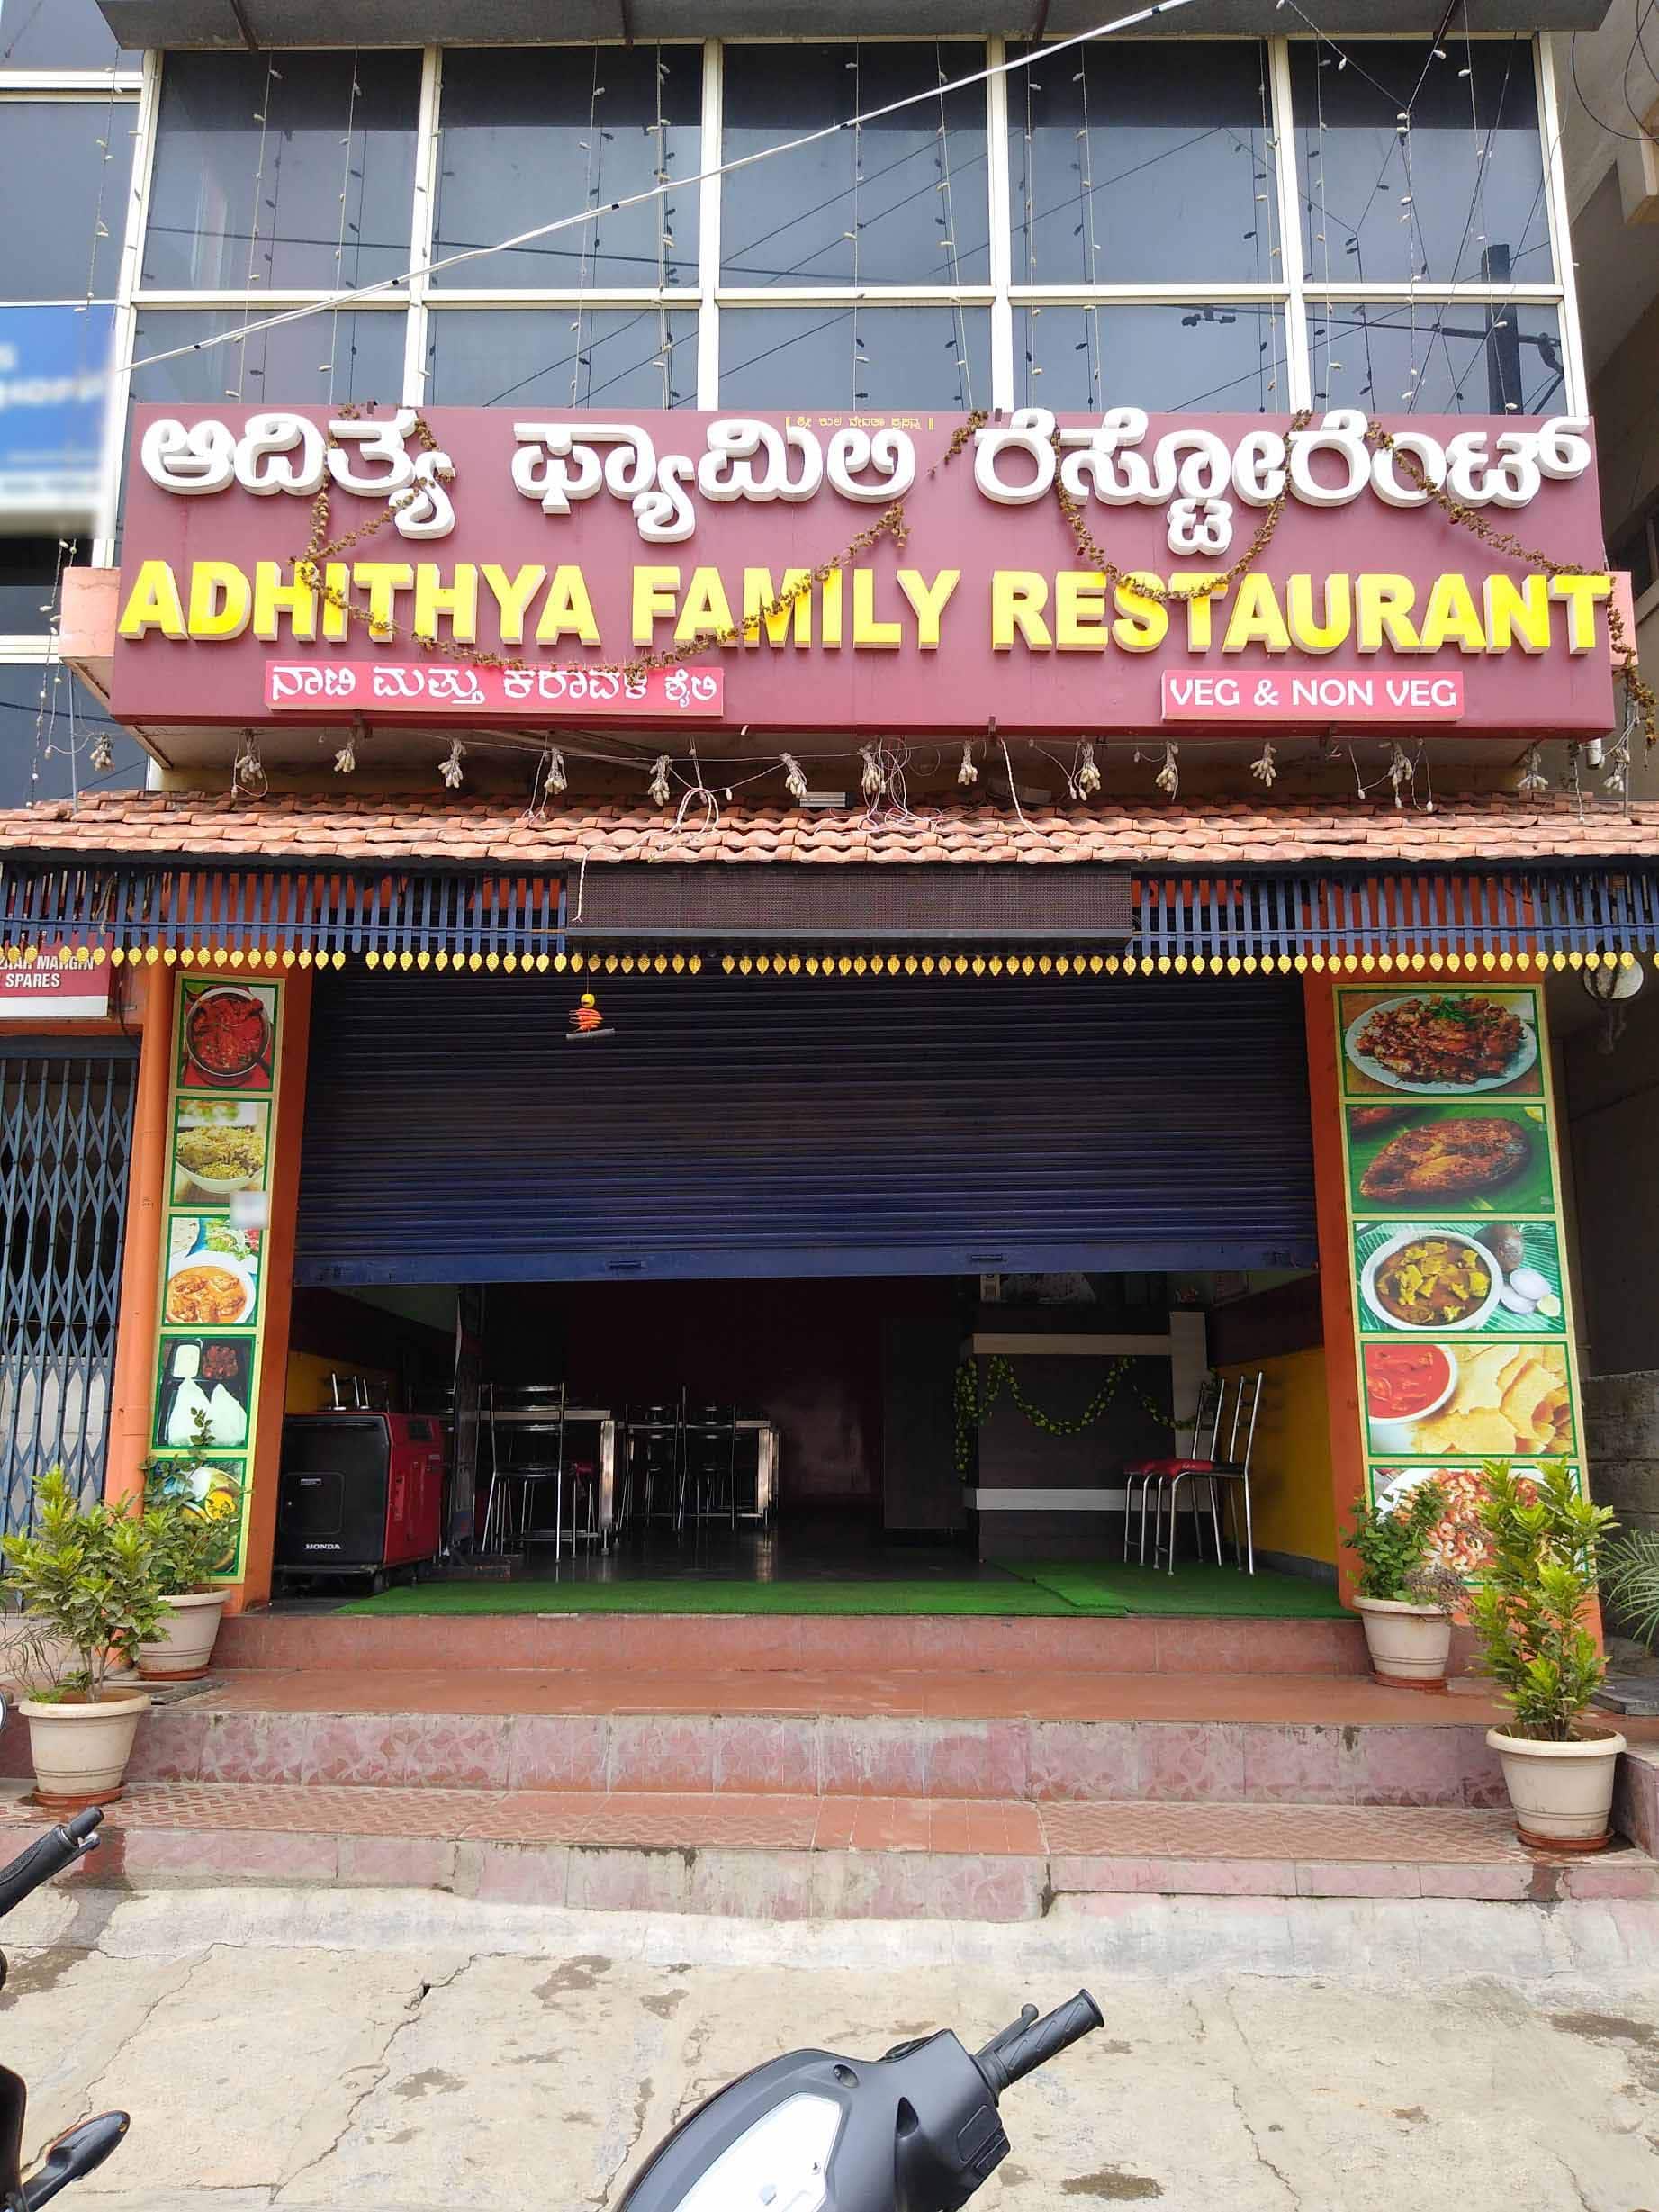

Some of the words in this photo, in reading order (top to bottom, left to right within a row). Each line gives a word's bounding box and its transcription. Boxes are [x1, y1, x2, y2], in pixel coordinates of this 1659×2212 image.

[511, 418, 915, 544] ಫ್ಯಾಮಿಲಿ
[118, 560, 602, 647] ADHITHYA
[632, 565, 960, 650] FAMILY
[992, 569, 1611, 655] RESTAURANT
[272, 665, 356, 701] ನಾಟಿ
[373, 665, 486, 705] ಮತ್ತು
[663, 668, 718, 709] ಶೈಲಿ
[1170, 678, 1240, 707] VEG
[1253, 679, 1279, 707] &
[1292, 679, 1373, 708] NON
[1384, 679, 1457, 708] VEG
[5, 973, 61, 988] SPARES
